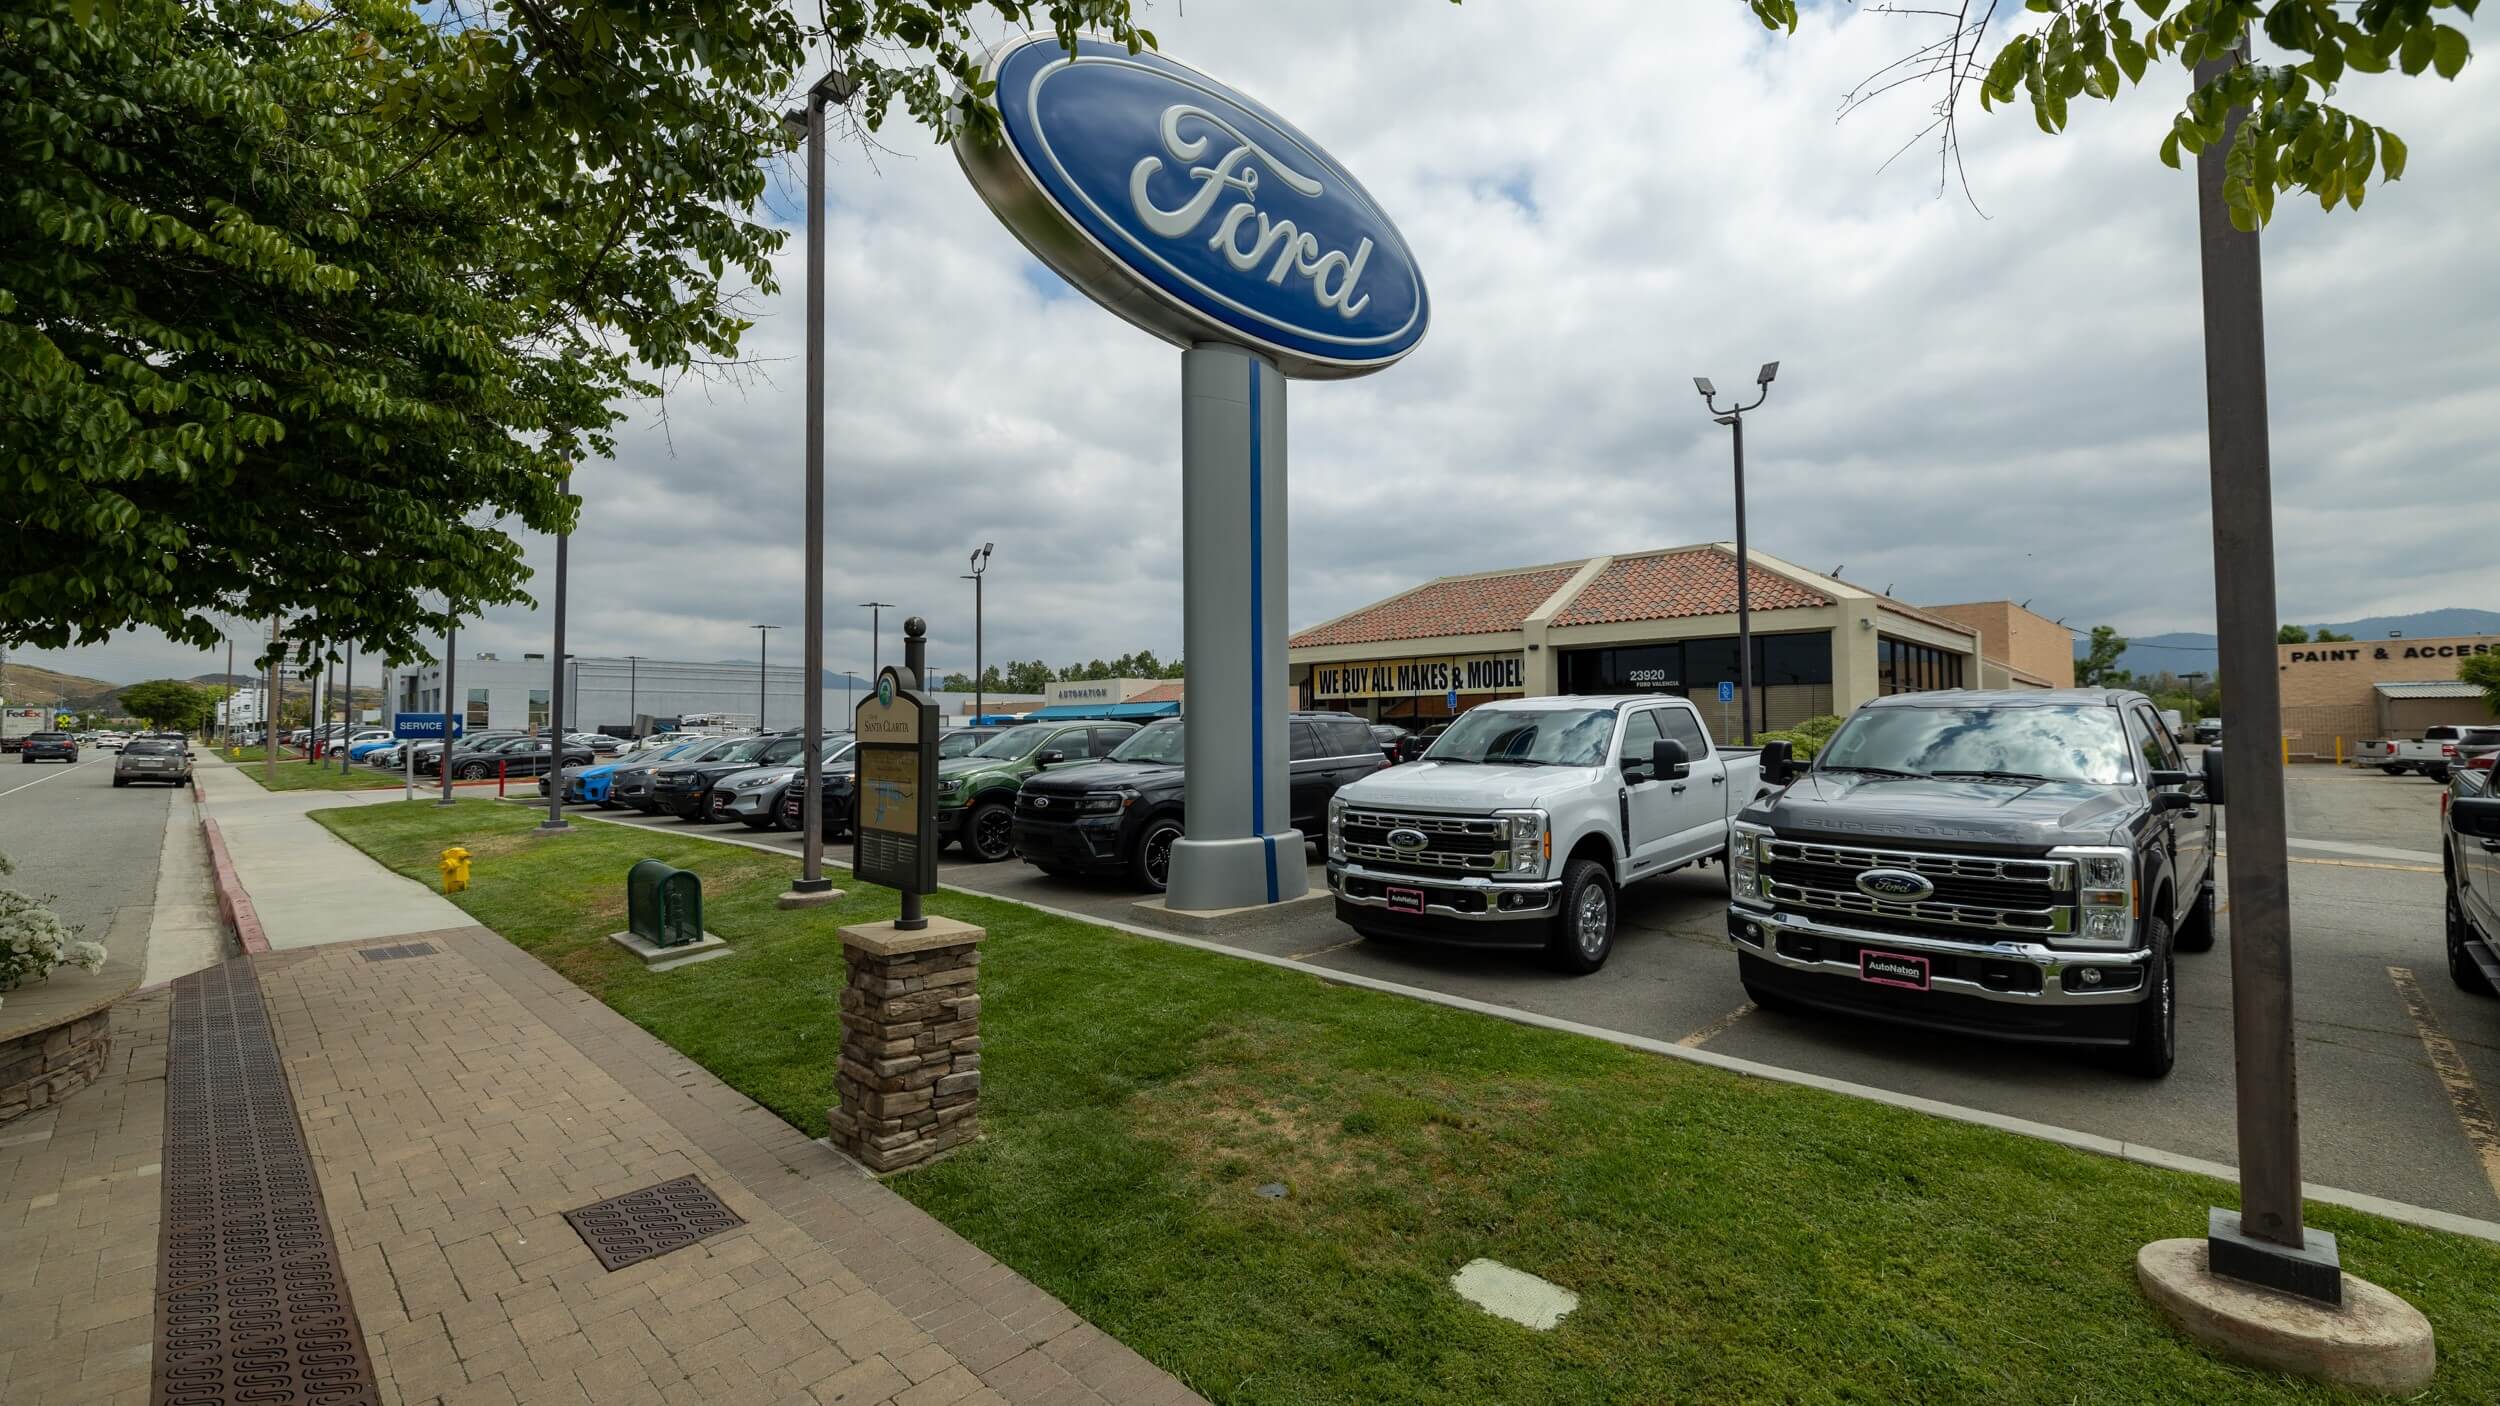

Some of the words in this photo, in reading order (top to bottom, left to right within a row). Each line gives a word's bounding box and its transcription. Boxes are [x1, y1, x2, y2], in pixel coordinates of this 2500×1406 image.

[1129, 104, 1370, 318] Ford
[2291, 649, 2360, 662] PAINT
[2373, 647, 2389, 660] &
[1319, 669, 1339, 694] WE
[1342, 667, 1368, 693] BUY
[1372, 665, 1394, 692] ALL
[1397, 662, 1449, 691] MAKES
[1452, 666, 1463, 690] &
[1467, 658, 1525, 688] MODEL
[1630, 669, 1665, 681] 23920
[1058, 688, 1107, 699] AUTONATION
[6, 709, 41, 718] FedEx
[400, 721, 442, 730] SERVICE
[864, 720, 883, 733] SANTA
[1802, 818, 1906, 834] SUPER
[1912, 823, 2024, 841] DUTY
[1875, 878, 1911, 894] Ford
[1868, 961, 1920, 976] AutoNation
